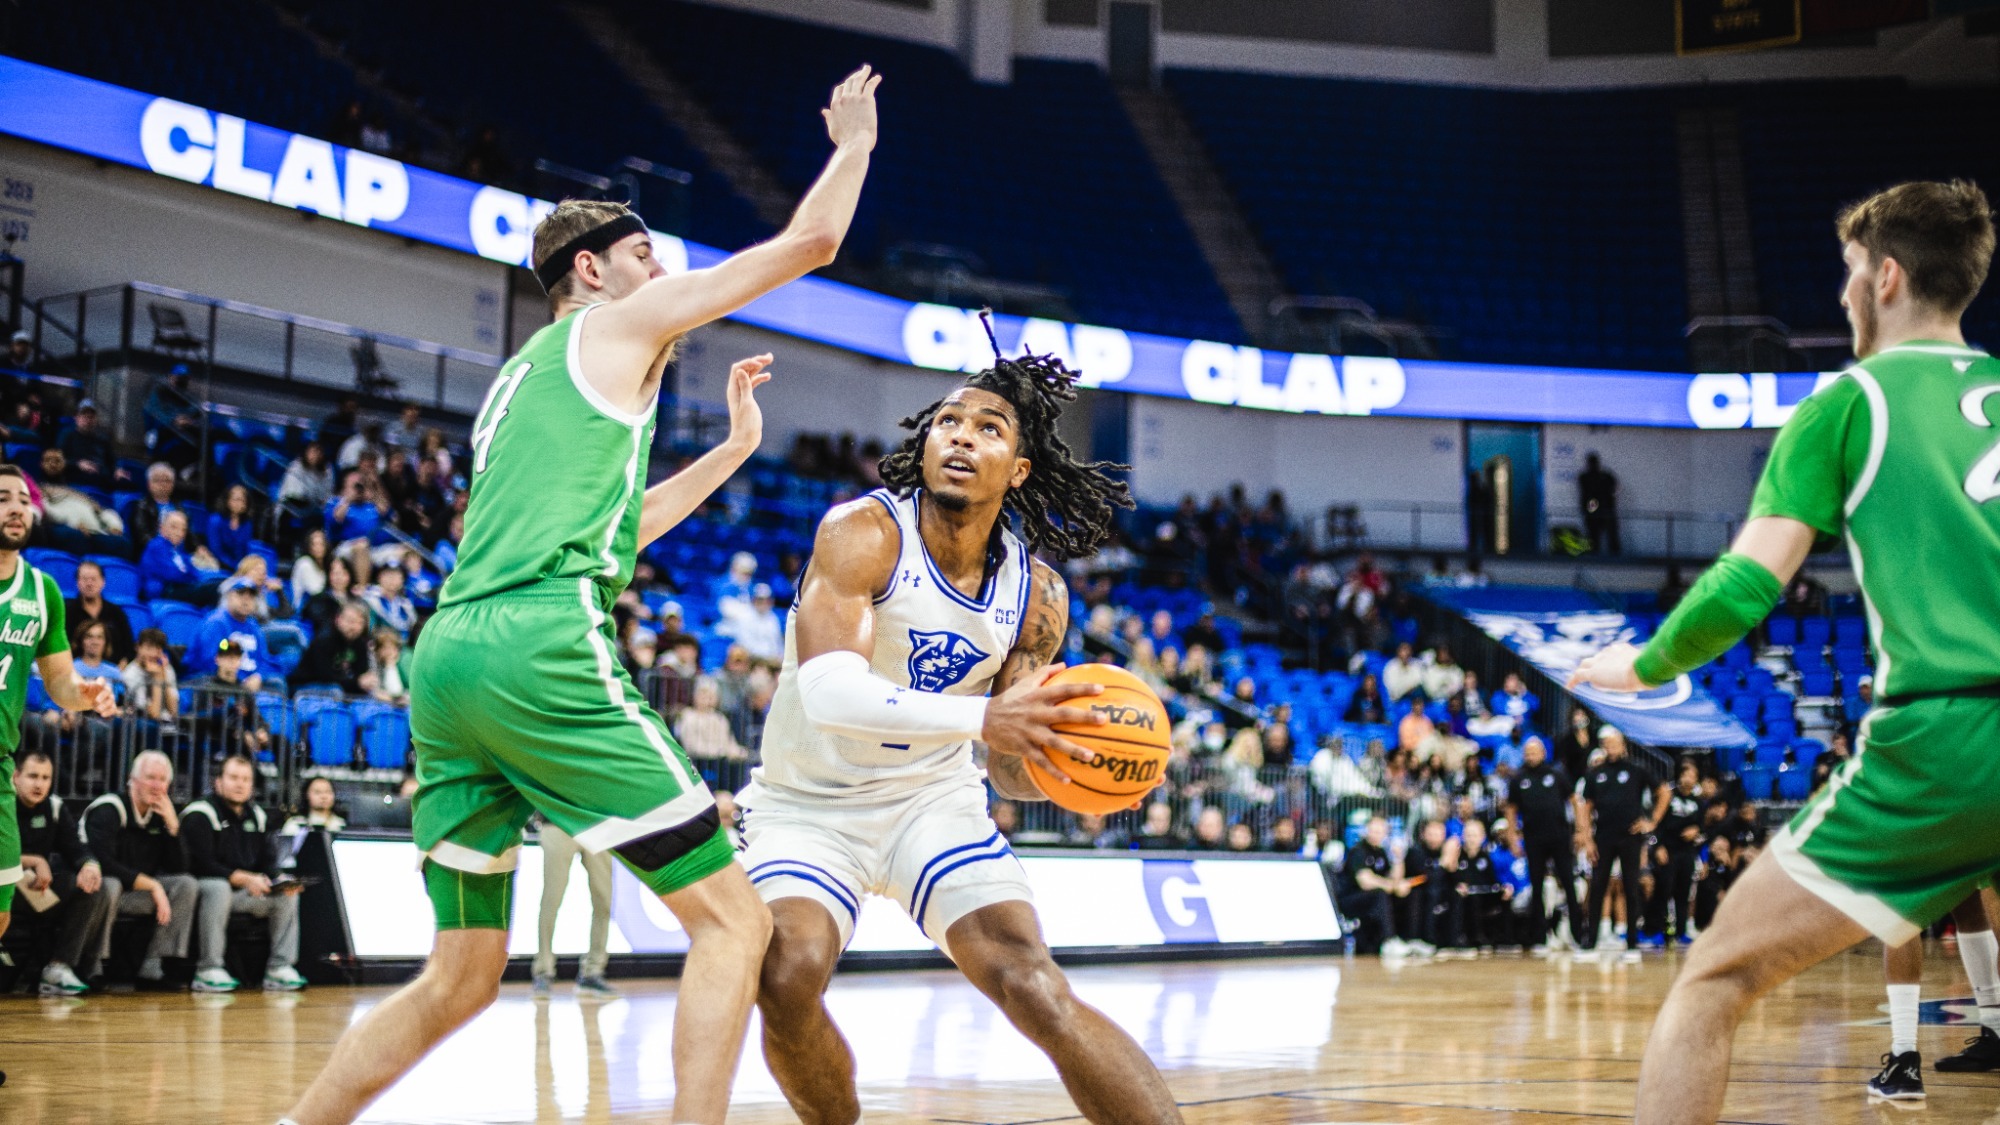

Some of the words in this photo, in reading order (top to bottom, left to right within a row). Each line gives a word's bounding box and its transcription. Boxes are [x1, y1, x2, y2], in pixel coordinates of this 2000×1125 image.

[140, 97, 409, 227] CLAP
[1181, 339, 1406, 416] CLAP
[1687, 372, 1846, 429] CL
[1142, 859, 1219, 944] G
